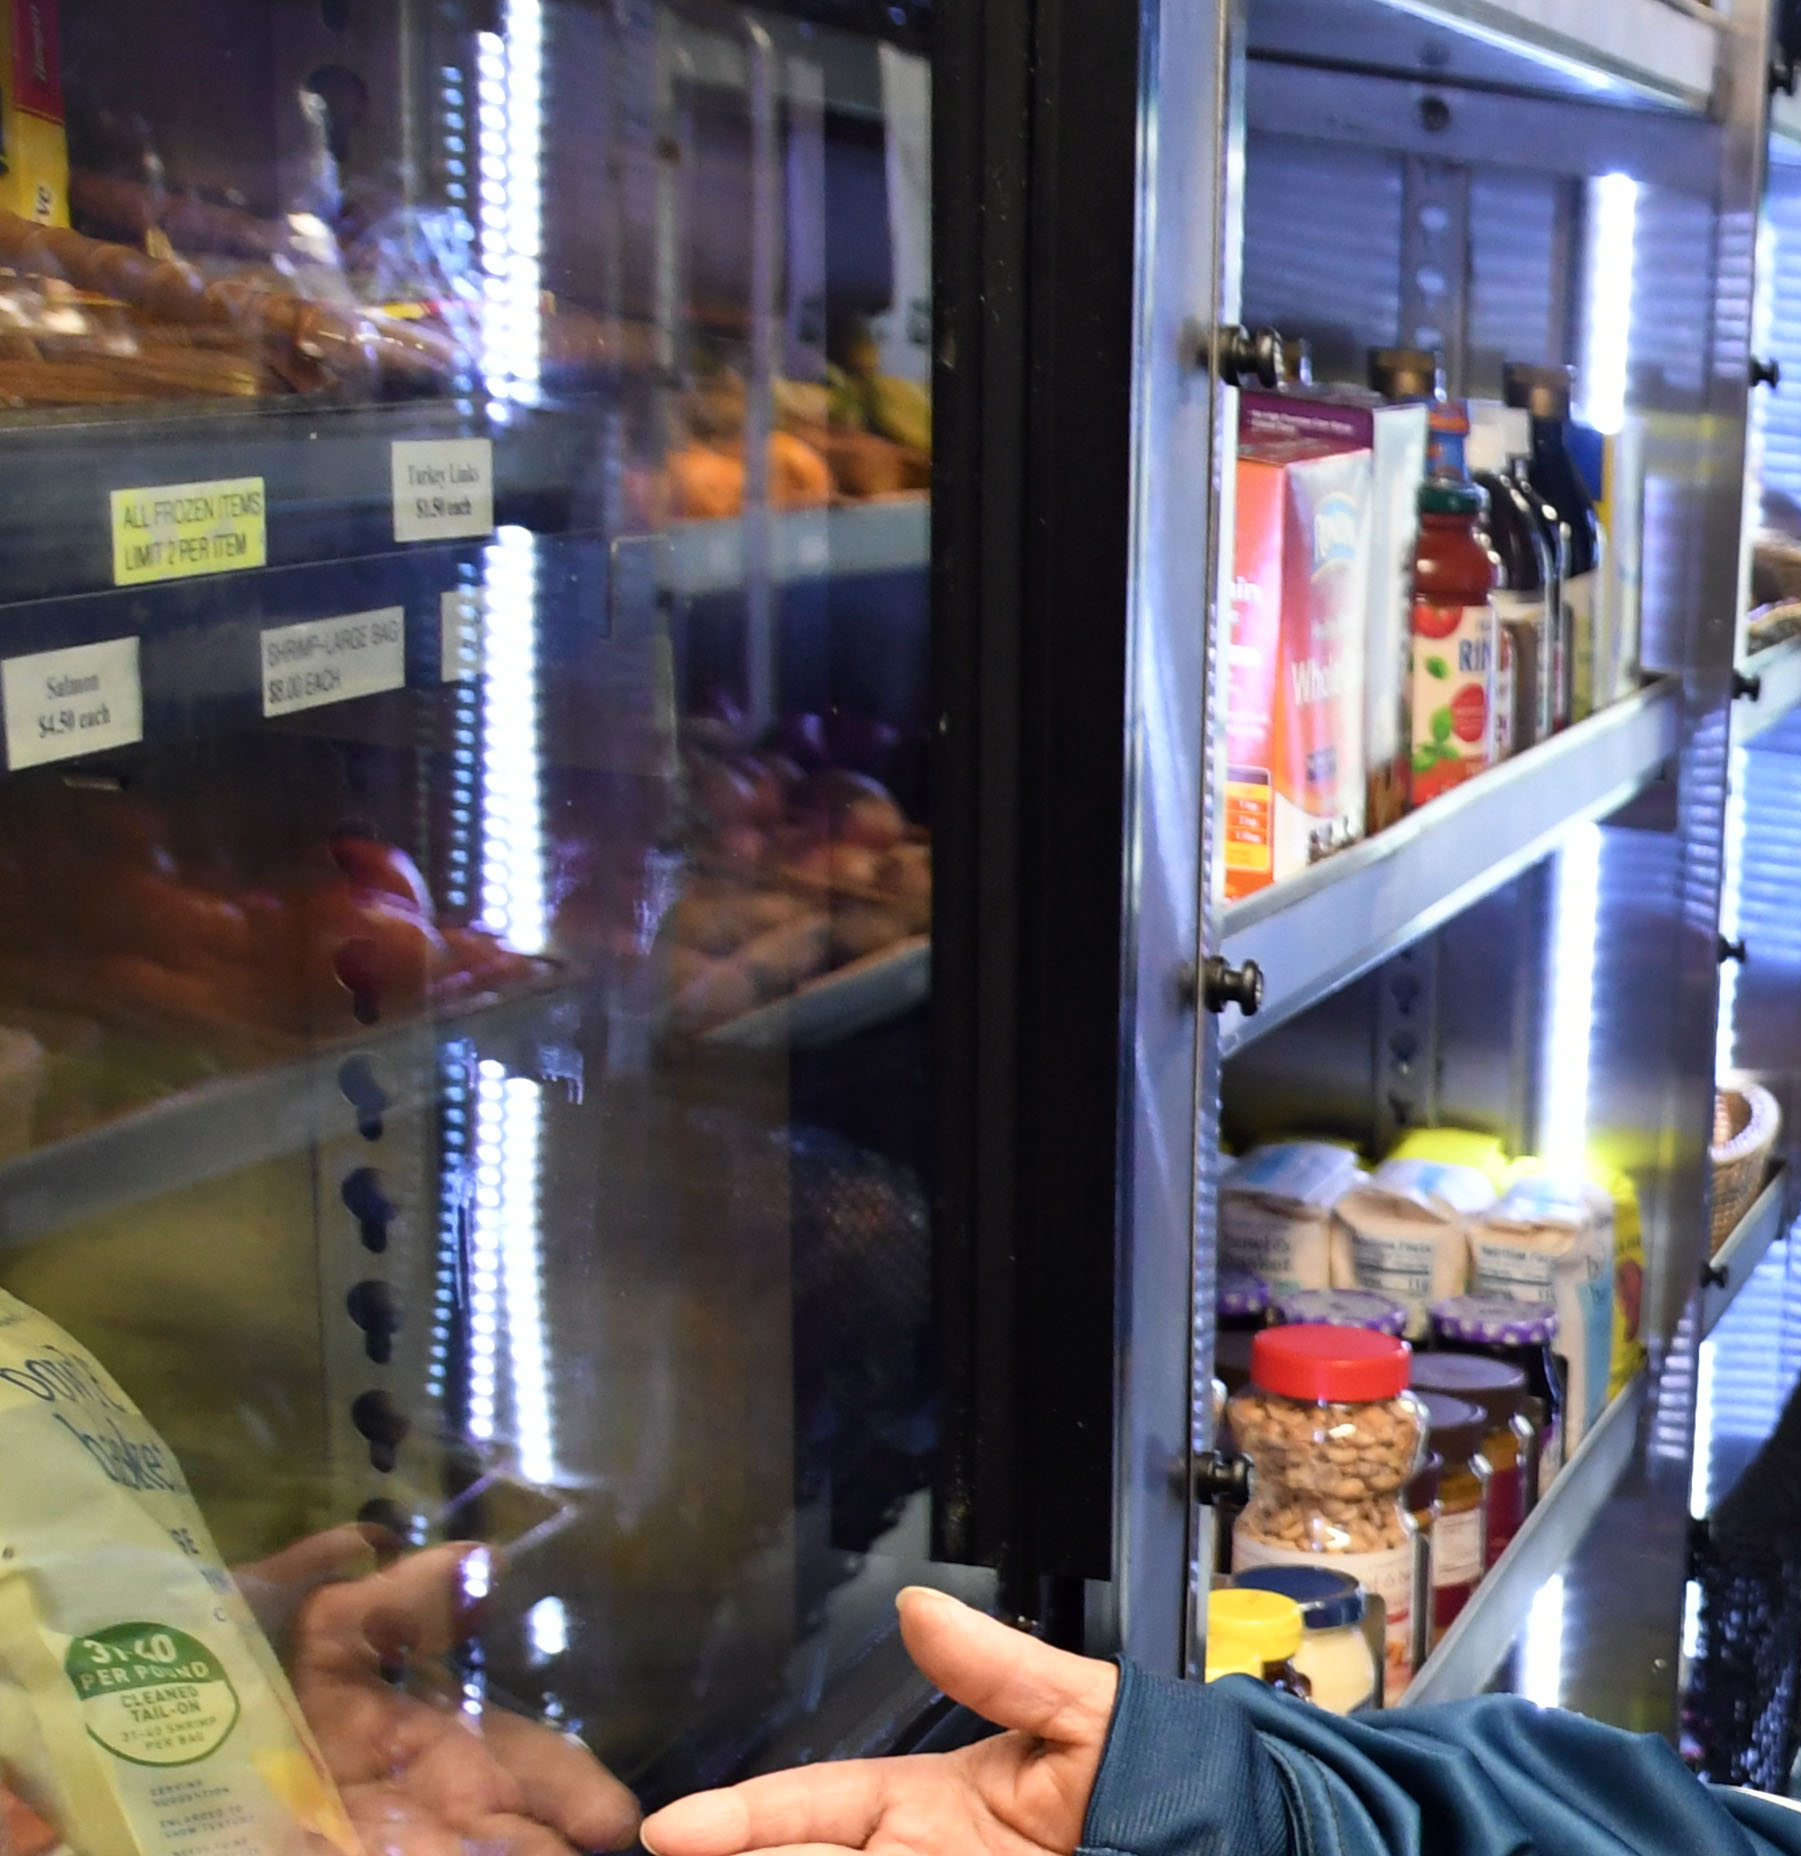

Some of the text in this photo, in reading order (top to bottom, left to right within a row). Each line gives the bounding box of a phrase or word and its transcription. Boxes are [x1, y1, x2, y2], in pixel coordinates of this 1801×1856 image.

[124, 491, 261, 528] ALL FROZEN ITEMS
[125, 540, 162, 571] LIMIT
[179, 536, 210, 562] PER
[213, 532, 247, 557] ITEM
[45, 672, 101, 701] Salmon
[78, 705, 112, 732] each
[80, 1660, 210, 1692] PER POUND
[120, 1685, 200, 1709] CLEANED
[130, 1699, 202, 1724] TAIL-ON
